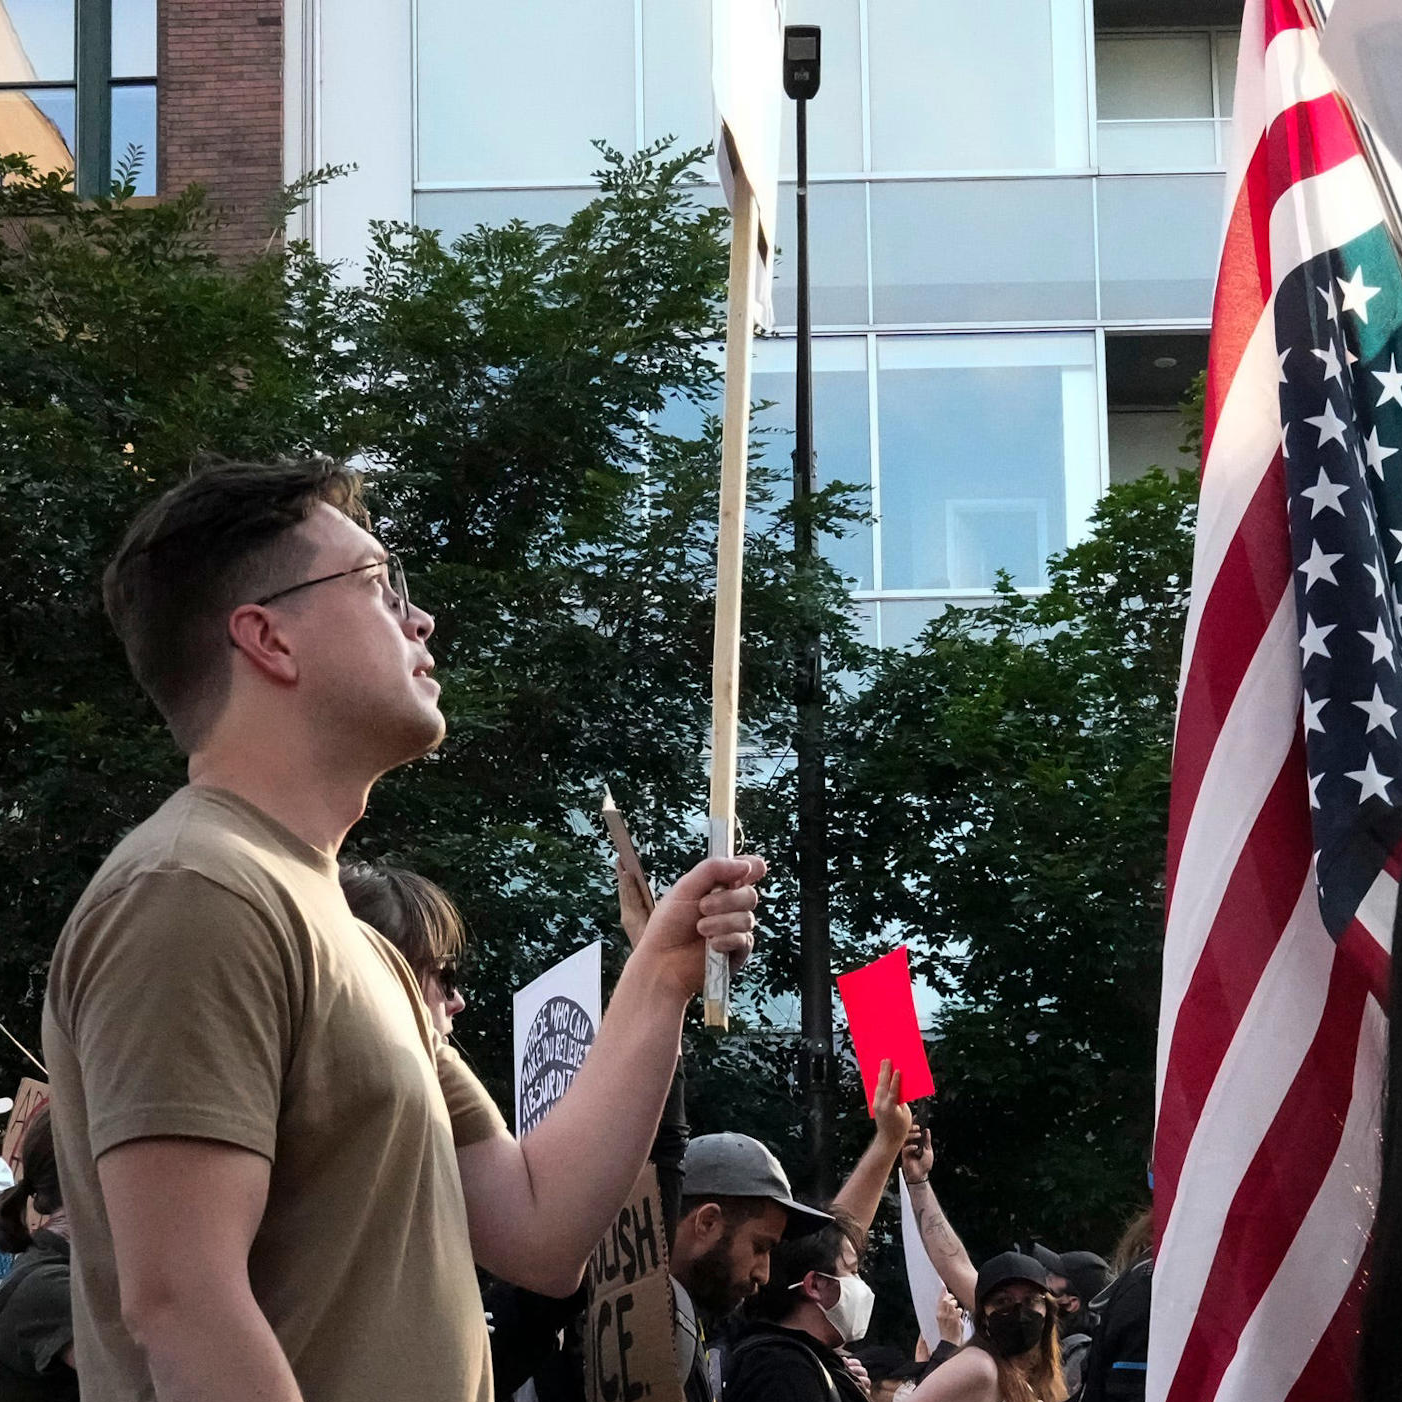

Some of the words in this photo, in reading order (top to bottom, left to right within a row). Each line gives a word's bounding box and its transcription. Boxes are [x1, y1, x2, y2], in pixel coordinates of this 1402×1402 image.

[524, 1004, 549, 1060] THOSE
[551, 1002, 569, 1031] WHO
[570, 1008, 590, 1040] CAN
[522, 1043, 543, 1095] MAKE
[541, 1036, 555, 1066] YOU
[555, 1034, 584, 1068] BELIEVE
